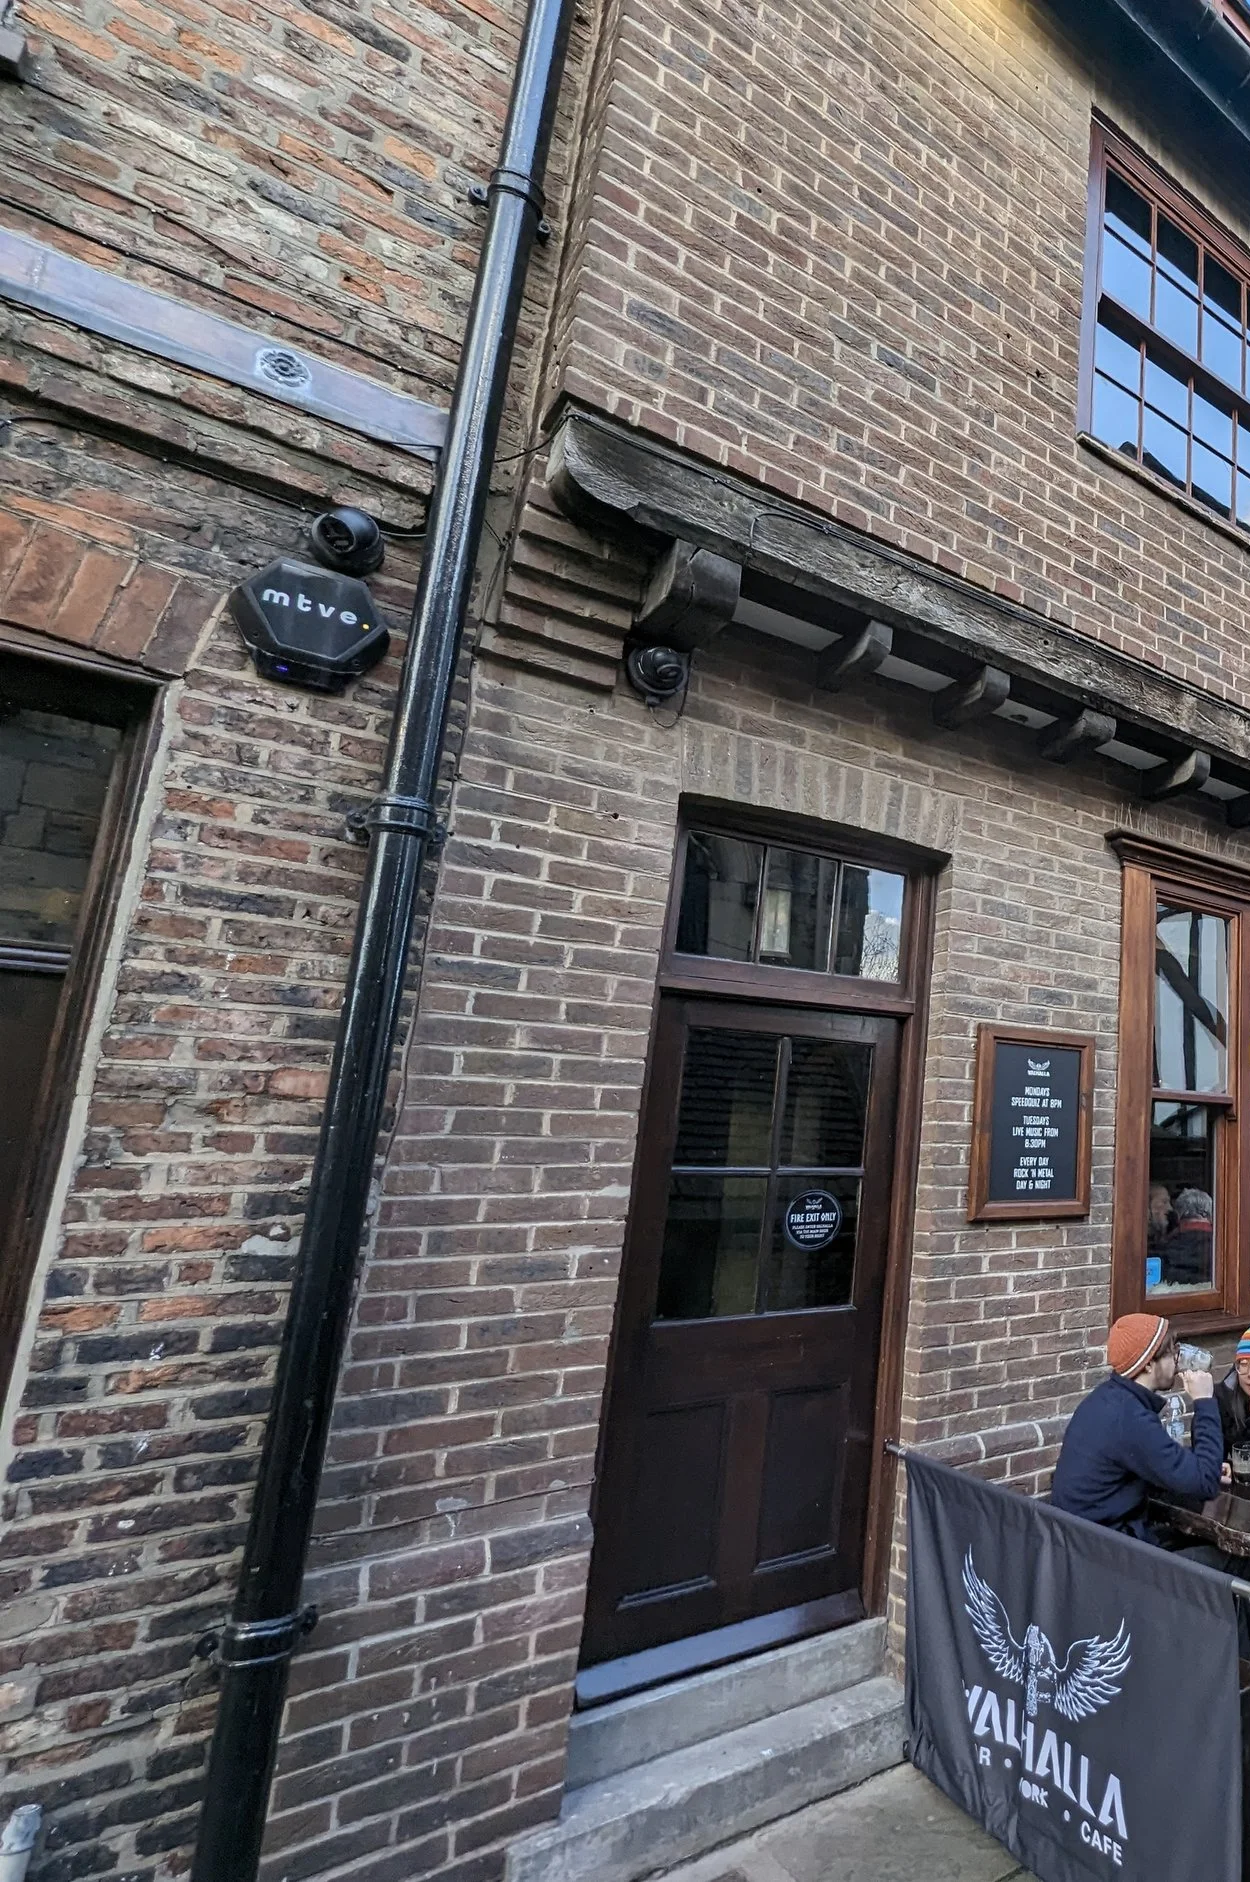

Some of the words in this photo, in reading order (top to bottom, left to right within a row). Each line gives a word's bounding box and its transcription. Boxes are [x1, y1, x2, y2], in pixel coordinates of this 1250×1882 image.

[1042, 1099, 1049, 1107] AT
[1050, 1099, 1062, 1108] 8PM
[1012, 1127, 1024, 1136] LIVE
[1025, 1127, 1043, 1137] MUSIC
[1044, 1128, 1059, 1137] FROM
[1020, 1157, 1037, 1166] EVERY
[1038, 1157, 1049, 1166] DAY
[1013, 1168, 1029, 1178] ROCK
[1038, 1168, 1054, 1178] METAL
[1016, 1180, 1027, 1190] DAY
[1028, 1180, 1034, 1190] &
[1035, 1180, 1051, 1189] NIGHT
[790, 1213, 804, 1223] FIRE
[806, 1212, 820, 1223] EXIT
[820, 1212, 837, 1222] ONLY
[1019, 1777, 1048, 1809] ORK
[1080, 1820, 1123, 1866] CAFE
